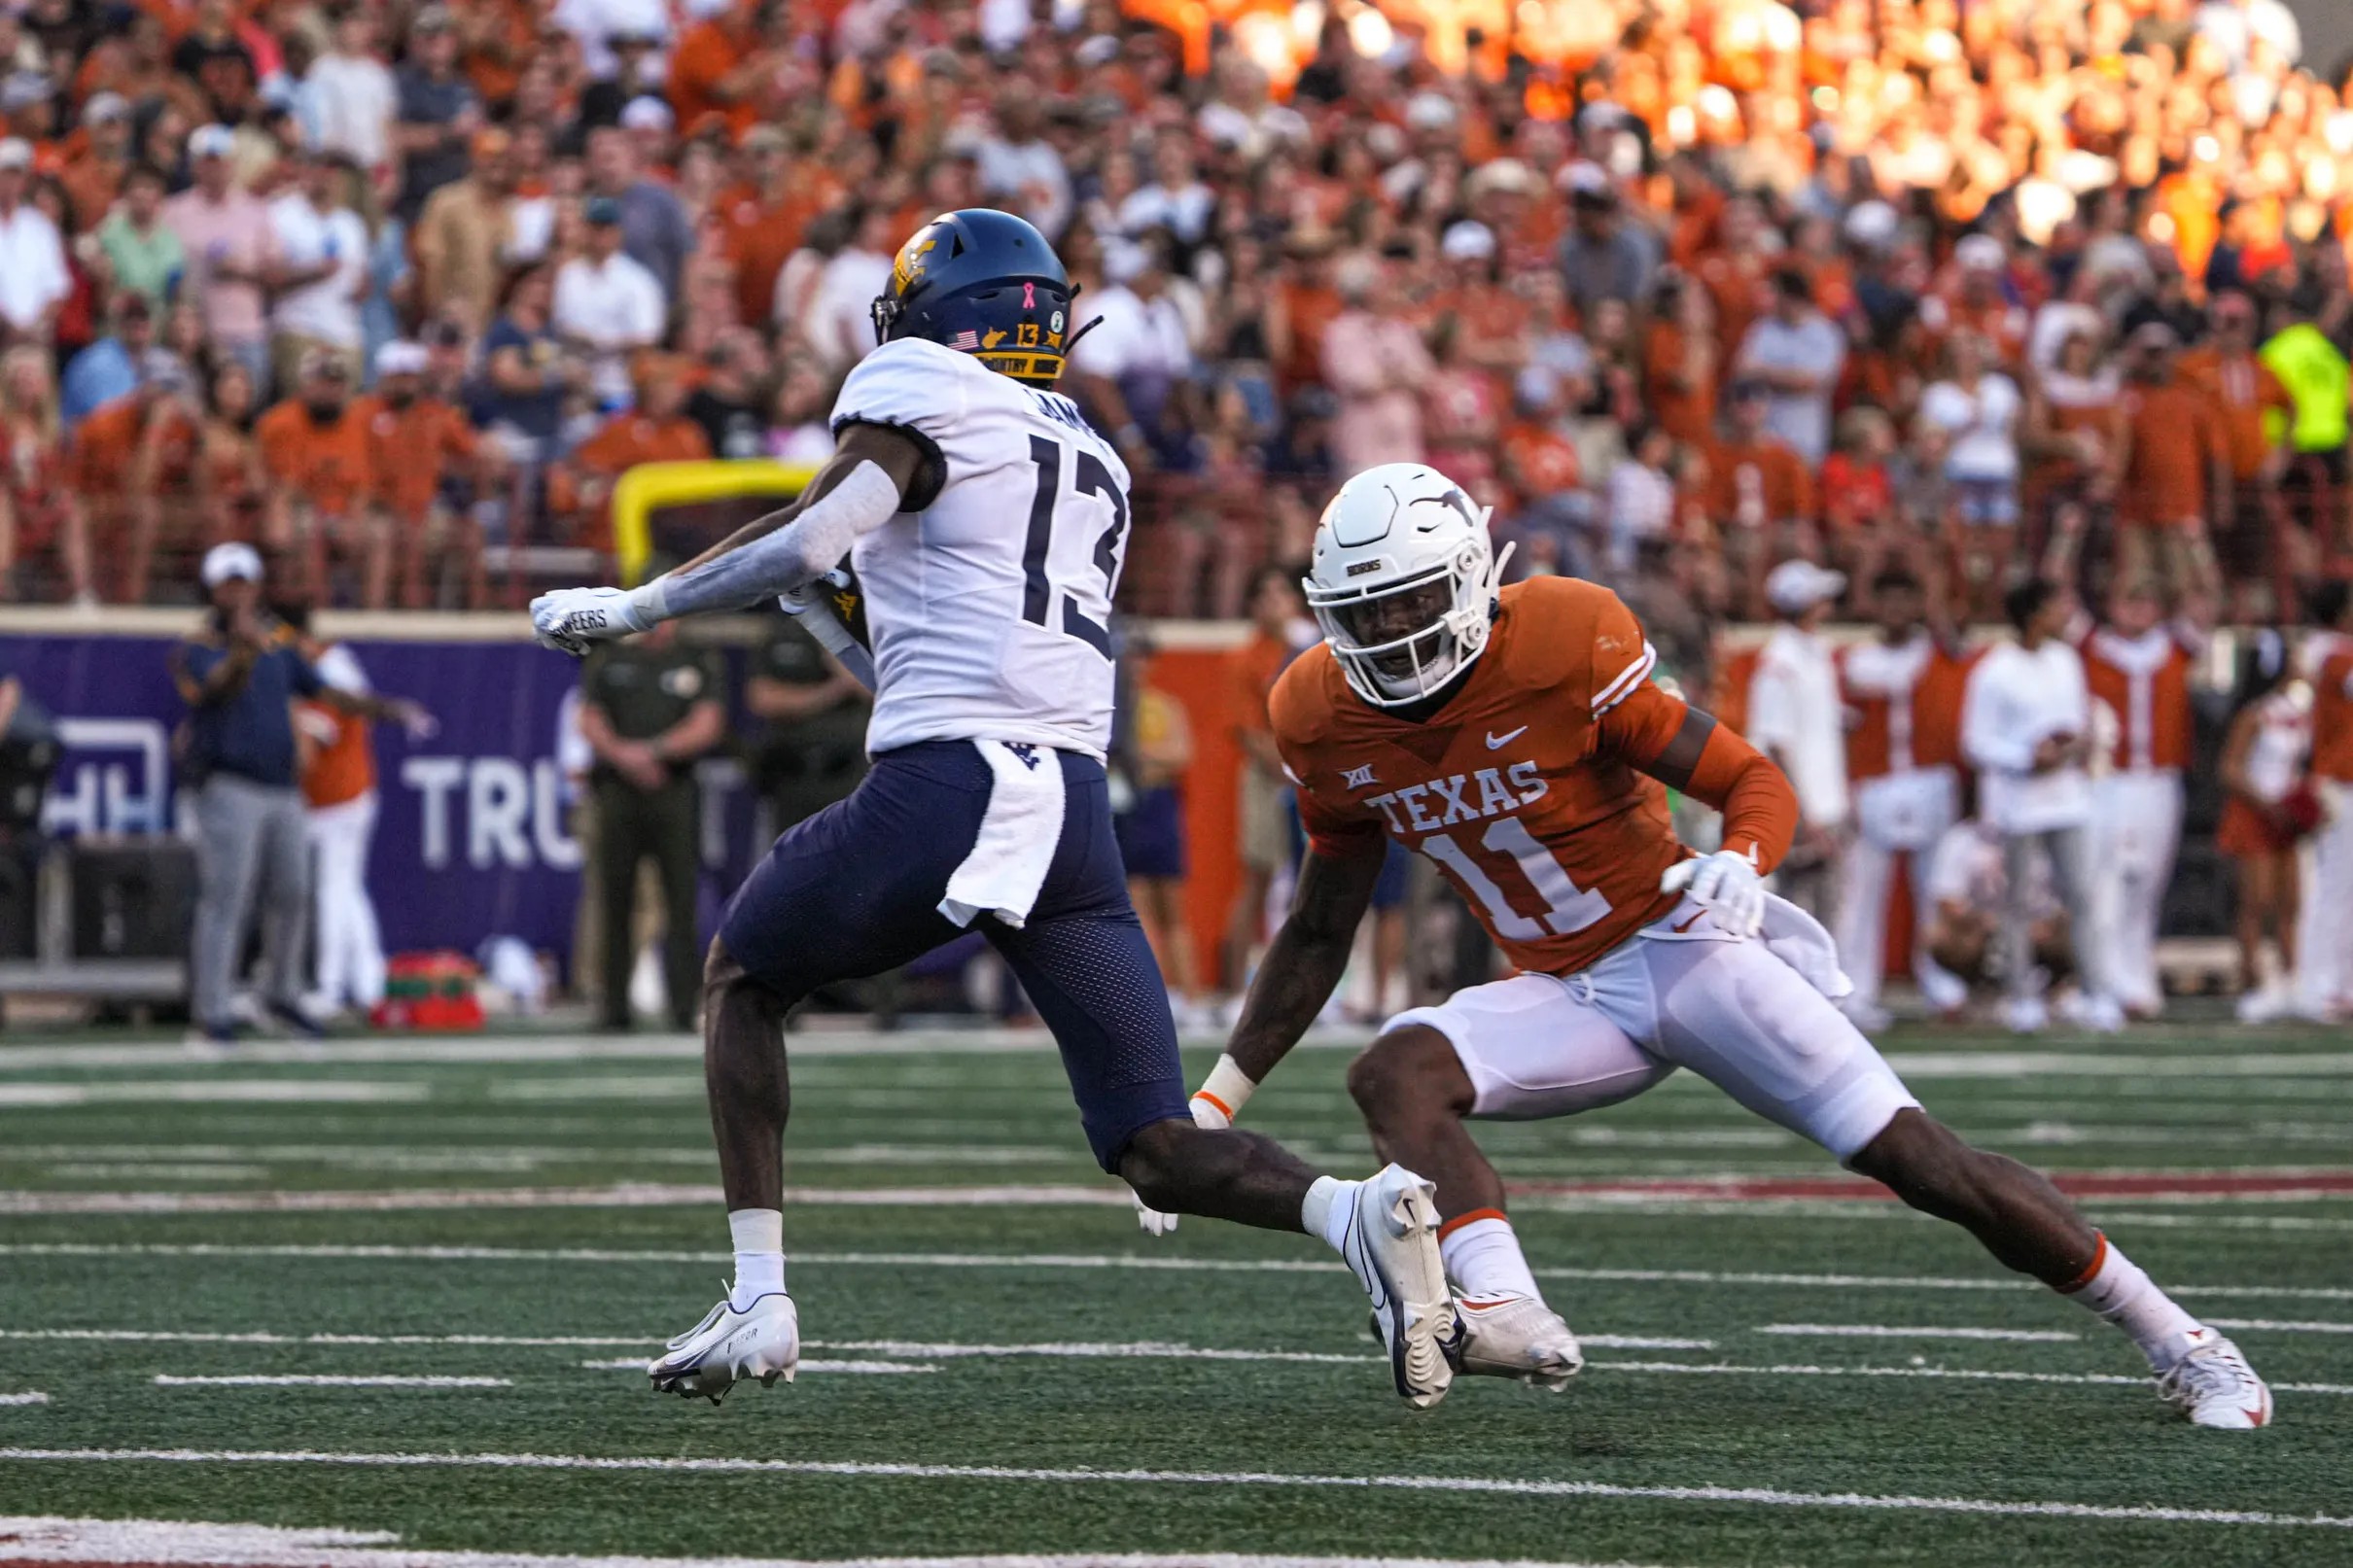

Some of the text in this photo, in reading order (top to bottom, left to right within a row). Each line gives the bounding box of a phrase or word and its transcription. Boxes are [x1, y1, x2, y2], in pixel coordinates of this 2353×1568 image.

[1017, 324, 1038, 348] 13
[1022, 434, 1124, 662] 13
[1364, 760, 1549, 833] TEXAS
[1421, 817, 1612, 941] 11
